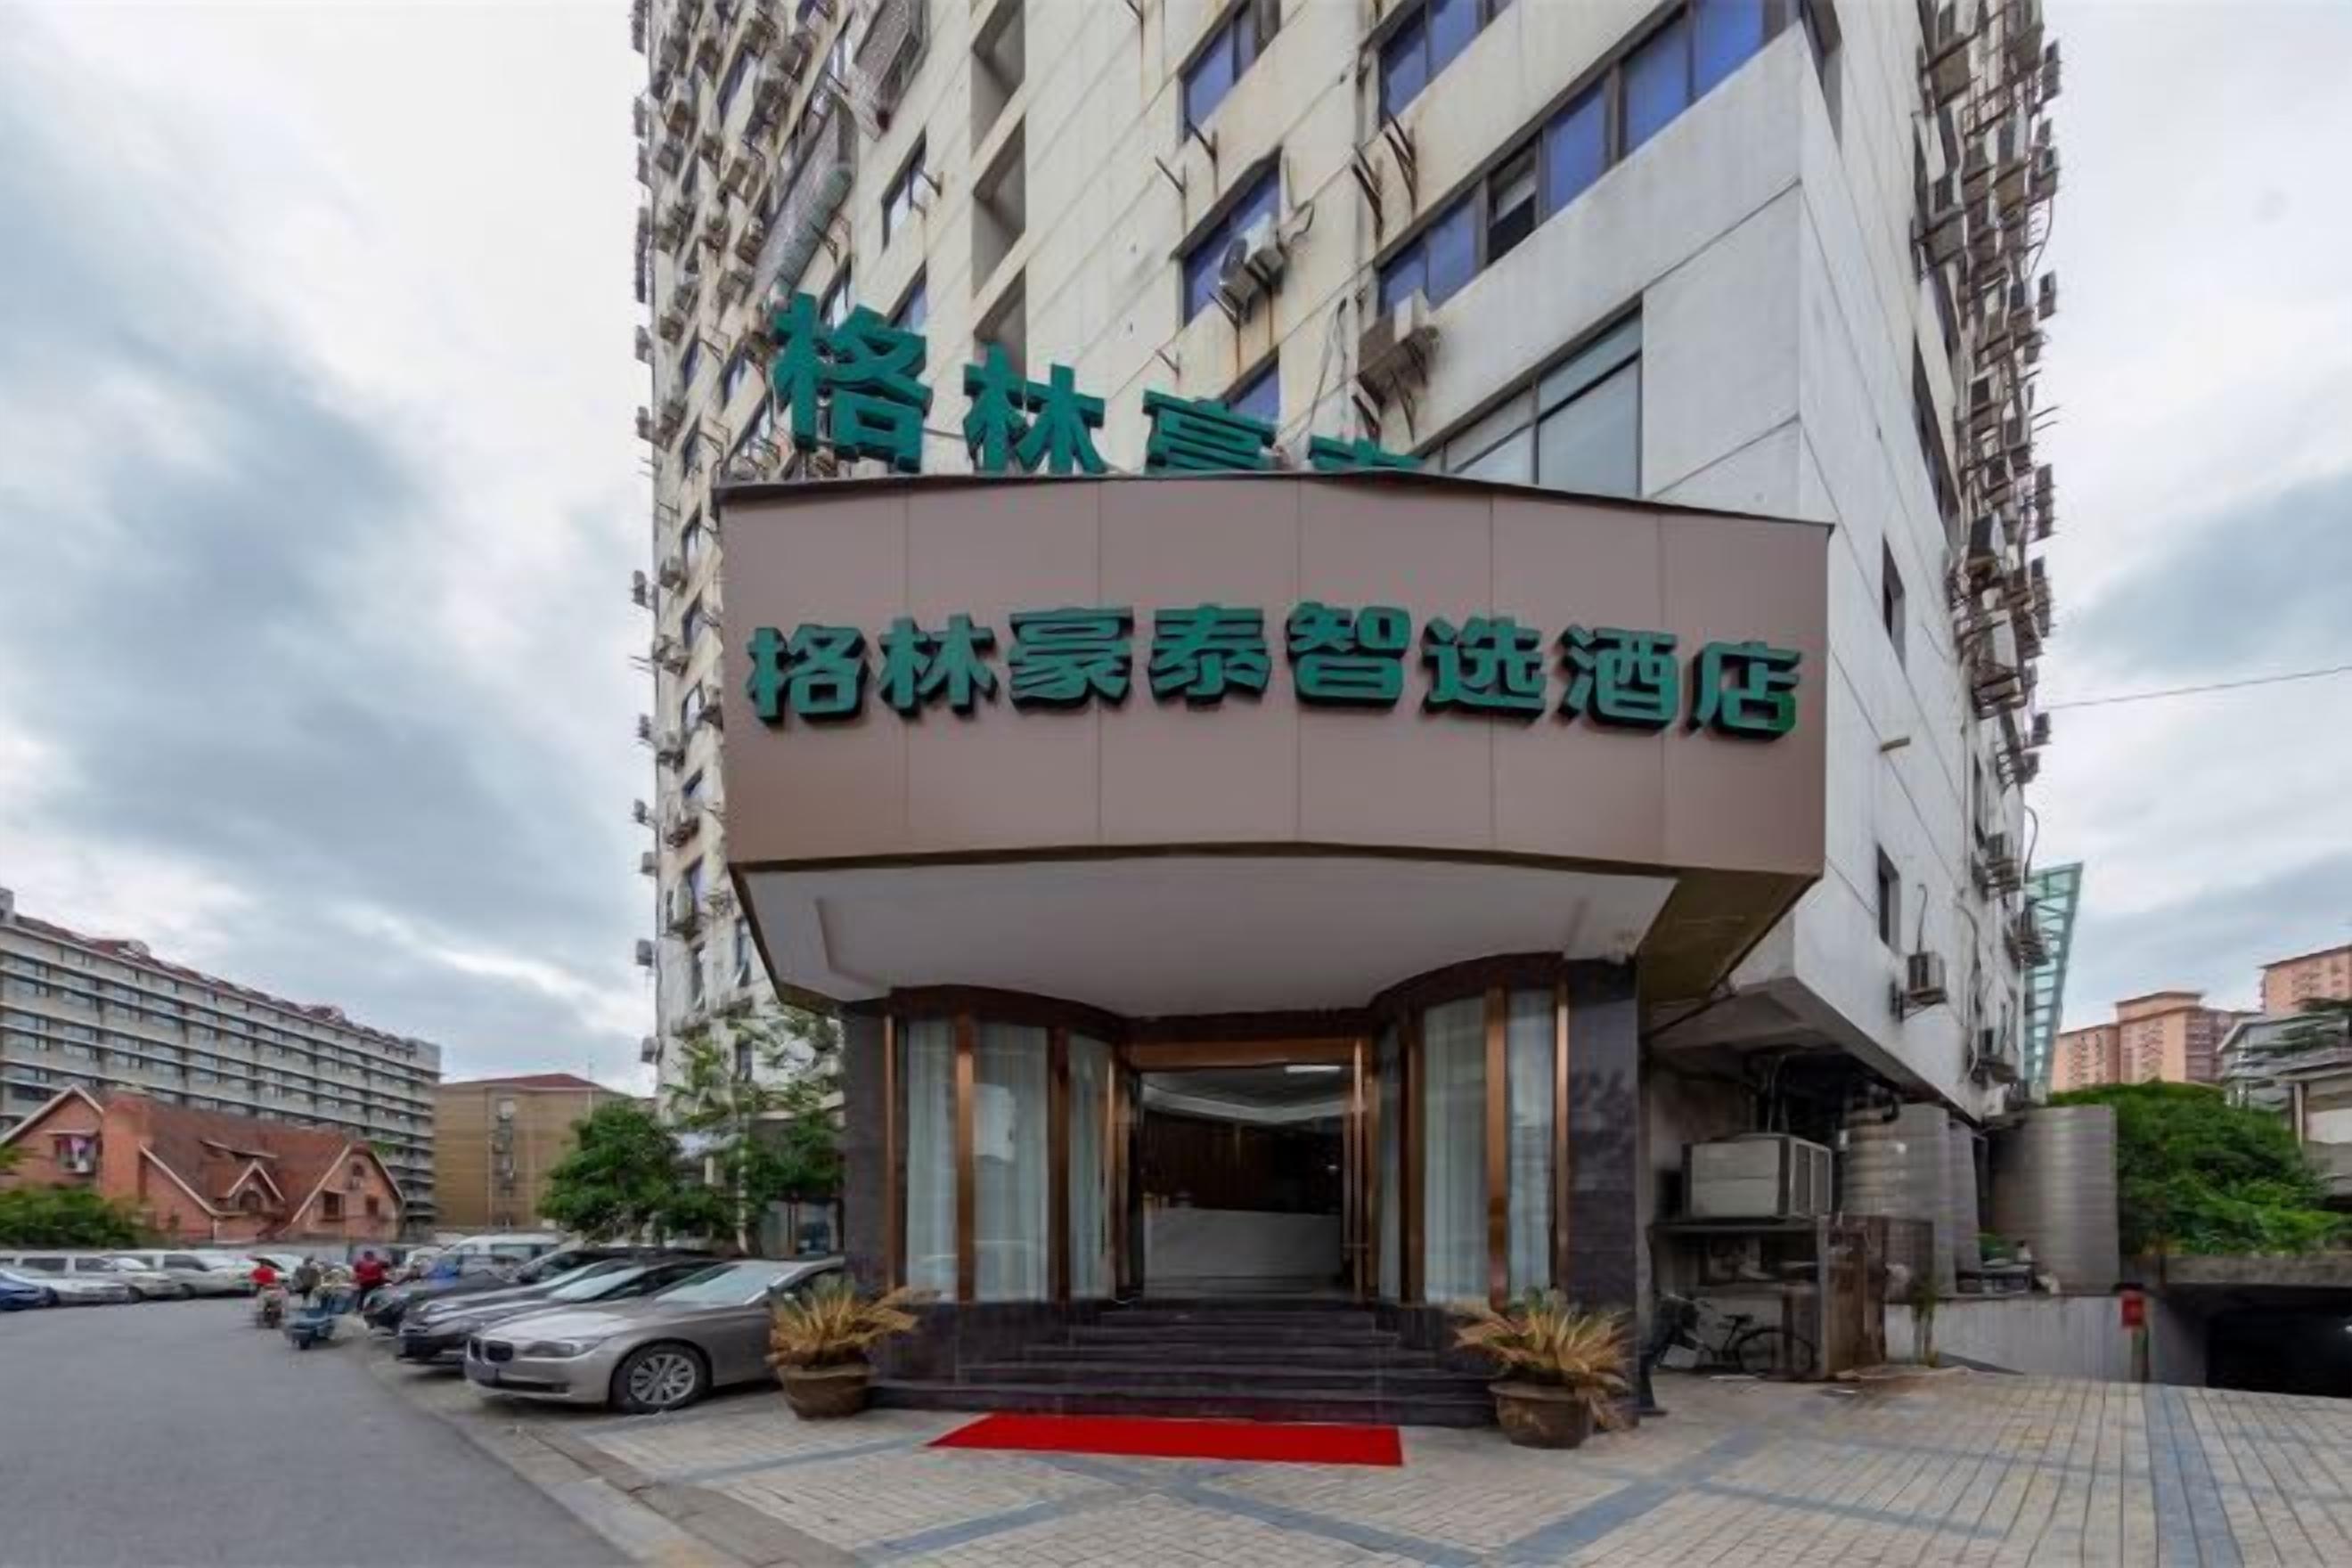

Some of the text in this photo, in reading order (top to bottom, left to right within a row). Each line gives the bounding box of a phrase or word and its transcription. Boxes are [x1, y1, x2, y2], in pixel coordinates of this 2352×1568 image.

[747, 600, 1801, 738] 格林豪泰智选酒店
